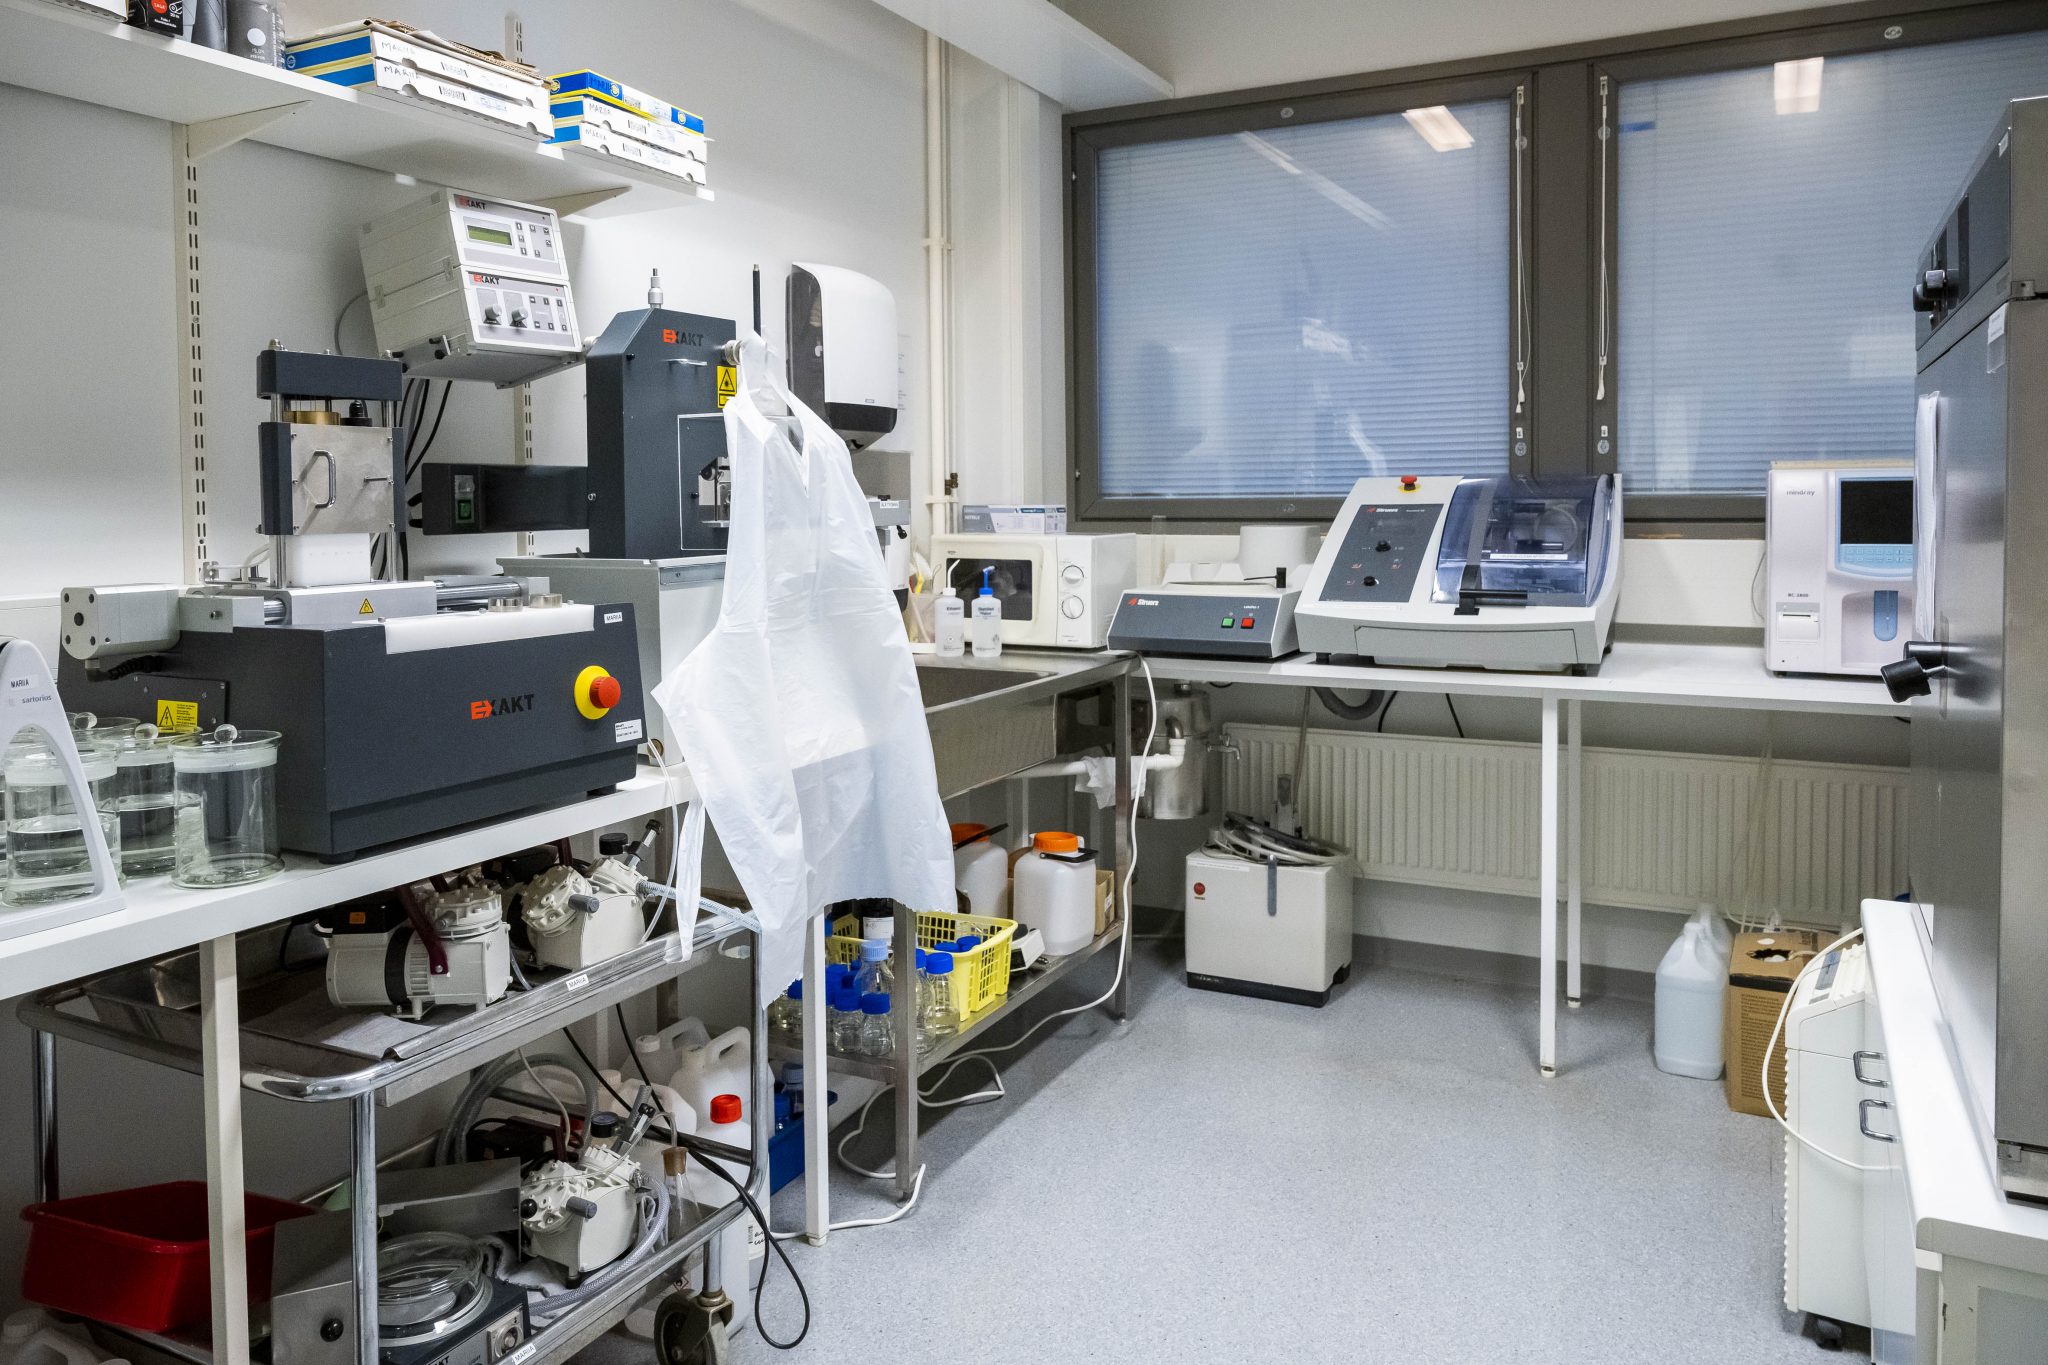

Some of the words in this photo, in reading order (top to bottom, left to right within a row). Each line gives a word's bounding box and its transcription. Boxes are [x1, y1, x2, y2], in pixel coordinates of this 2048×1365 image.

[458, 198, 486, 210] EXAKT
[473, 273, 499, 285] EXAKT
[662, 328, 704, 347] EXAKT
[21, 695, 52, 704] sartorius
[470, 693, 534, 721] EXAKT
